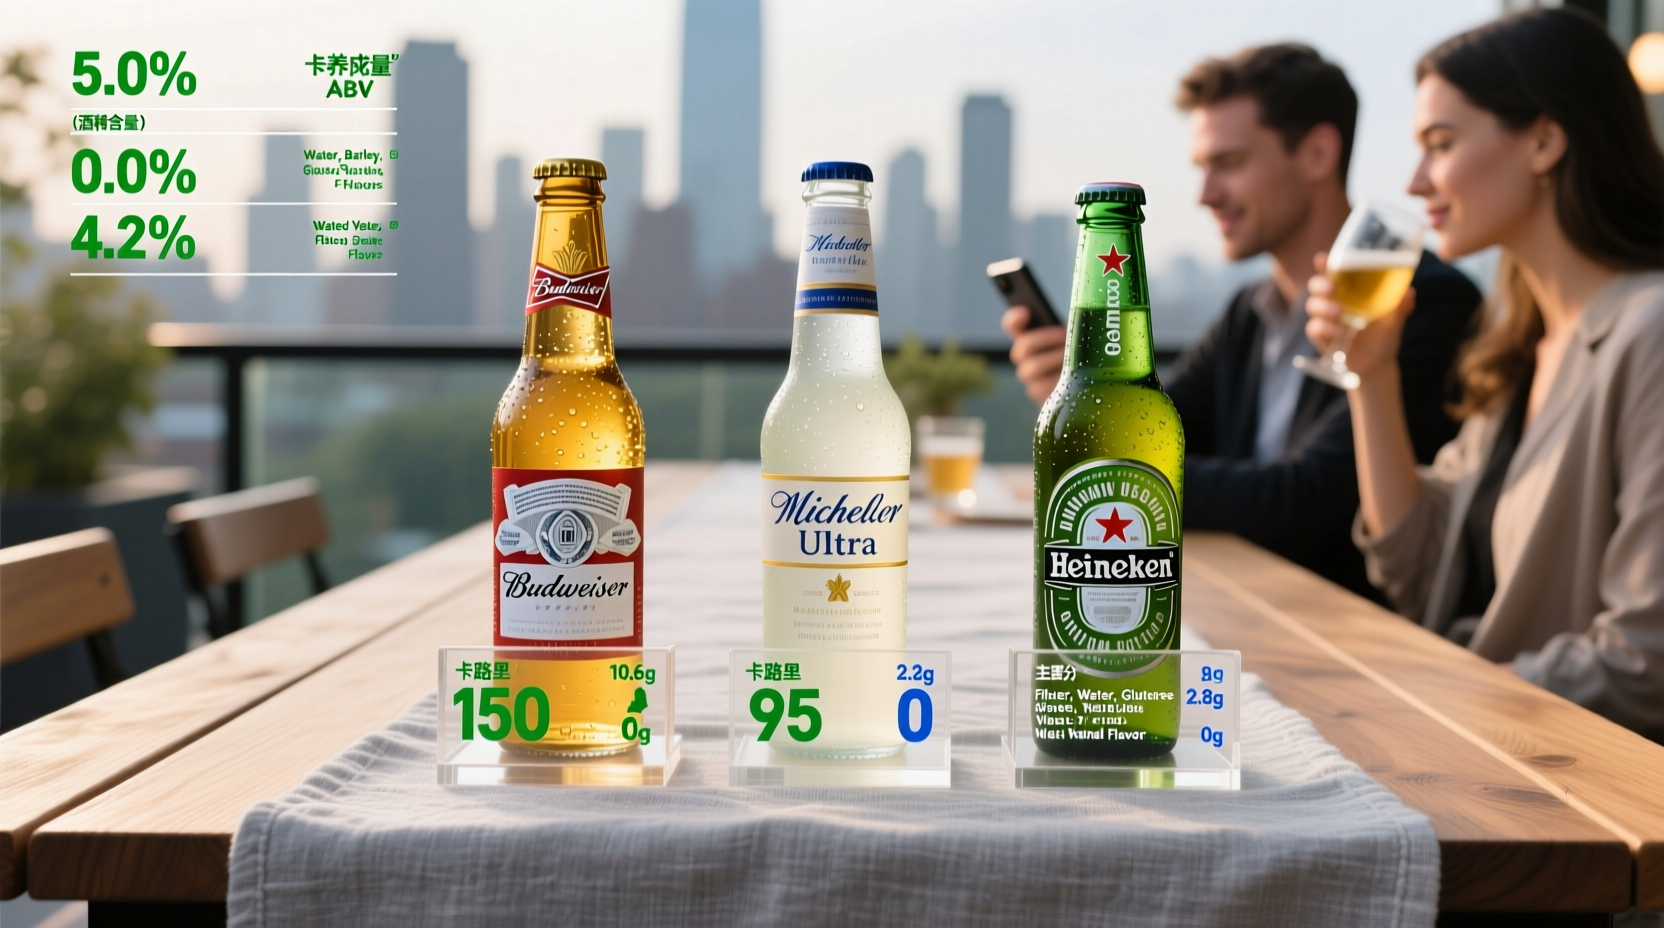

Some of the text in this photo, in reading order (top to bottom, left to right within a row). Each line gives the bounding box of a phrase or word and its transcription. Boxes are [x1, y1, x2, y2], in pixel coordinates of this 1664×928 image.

[799, 529, 878, 556] Ultra
[503, 571, 629, 598] Budweiser
[455, 661, 511, 681] 卡路里
[610, 664, 656, 684] 10.6g
[746, 662, 802, 681] 卡路里
[896, 664, 935, 686] 2.2g
[1186, 688, 1224, 710] 2.8g
[453, 686, 550, 742] 150
[749, 688, 823, 742] 95
[897, 688, 934, 743] 0
[621, 716, 651, 745] 0g
[1201, 726, 1223, 748] 0g
